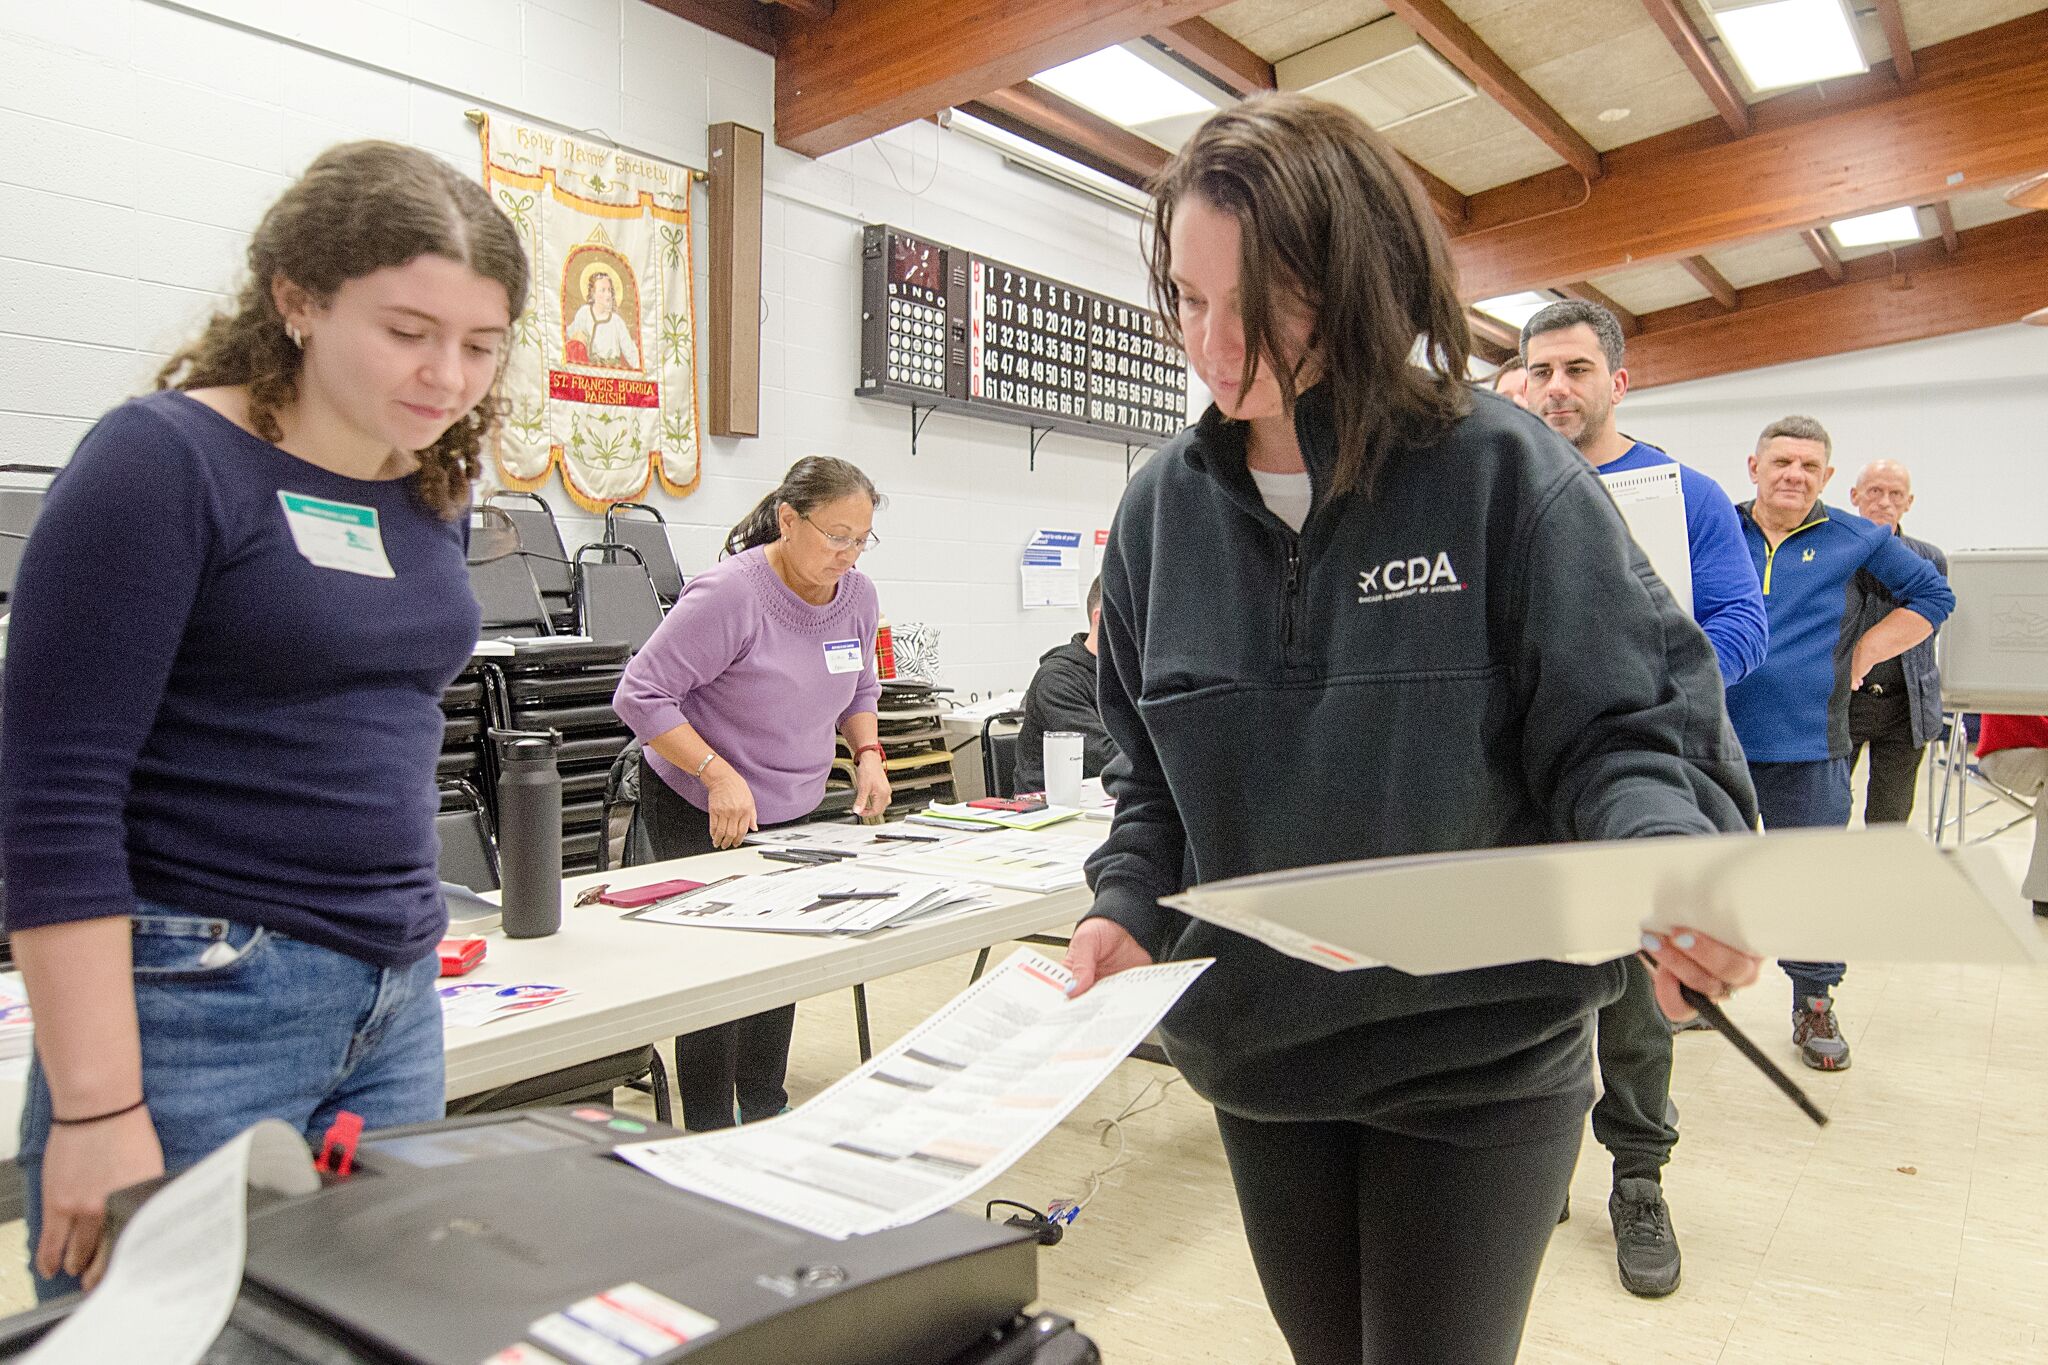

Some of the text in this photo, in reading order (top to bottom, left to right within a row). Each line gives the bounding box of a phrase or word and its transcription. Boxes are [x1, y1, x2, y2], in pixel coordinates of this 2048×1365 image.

[516, 128, 668, 186] Holy Name Society
[889, 284, 946, 308] BINGO
[989, 268, 994, 288] 1
[1004, 272, 1012, 293] 2
[1019, 277, 1026, 298] 3
[1034, 282, 1041, 302] 4
[1049, 286, 1056, 306] 5
[1064, 291, 1070, 311] 6
[1077, 296, 1084, 314] 7
[1094, 300, 1101, 320] 8
[1108, 304, 1114, 324] 9
[1118, 309, 1128, 328] 10
[1131, 312, 1140, 331] 11
[1142, 316, 1152, 335] 12
[986, 294, 997, 317] 16
[1002, 299, 1013, 320] 17
[1017, 304, 1028, 325] 18
[1032, 308, 1043, 329] 19
[1046, 312, 1058, 334] 20
[1060, 316, 1072, 337] 21
[1074, 320, 1086, 340] 22
[1092, 325, 1103, 345] 23
[1105, 328, 1116, 348] 24
[1118, 332, 1128, 352] 25
[1130, 336, 1140, 356] 26
[1142, 339, 1152, 358] 27
[1154, 342, 1164, 362] 28
[986, 321, 1186, 390] 31 32 33 34 35 36 37 38 39 40 41 42 43 44 45
[554, 374, 654, 396] ST. FRANCIS BORGIA
[584, 392, 626, 404] PARISH
[984, 350, 998, 372] 46
[1000, 354, 1014, 376] 47
[1016, 358, 1029, 379] 48
[1031, 361, 1044, 383] 49
[1046, 364, 1058, 386] 50
[1060, 367, 1071, 388] 51
[1074, 370, 1086, 392] 52
[1091, 374, 1103, 395] 53
[1104, 378, 1116, 398] 54
[1117, 380, 1128, 400] 55
[1129, 384, 1140, 403] 56
[1142, 386, 1152, 406] 57
[986, 378, 998, 400] 61
[1000, 380, 1014, 404] 62
[1016, 384, 1028, 406] 63
[1031, 388, 1044, 409] 64
[1046, 390, 1058, 412] 65
[1060, 394, 1072, 414] 66
[1074, 396, 1086, 416] 67
[1091, 400, 1102, 420] 68
[1104, 402, 1115, 422] 69
[1117, 406, 1128, 424] 70
[1130, 408, 1138, 428] 71
[1142, 410, 1152, 430] 72
[1153, 413, 1162, 432] 73
[1164, 416, 1174, 434] 74
[1382, 552, 1458, 591] CDA
